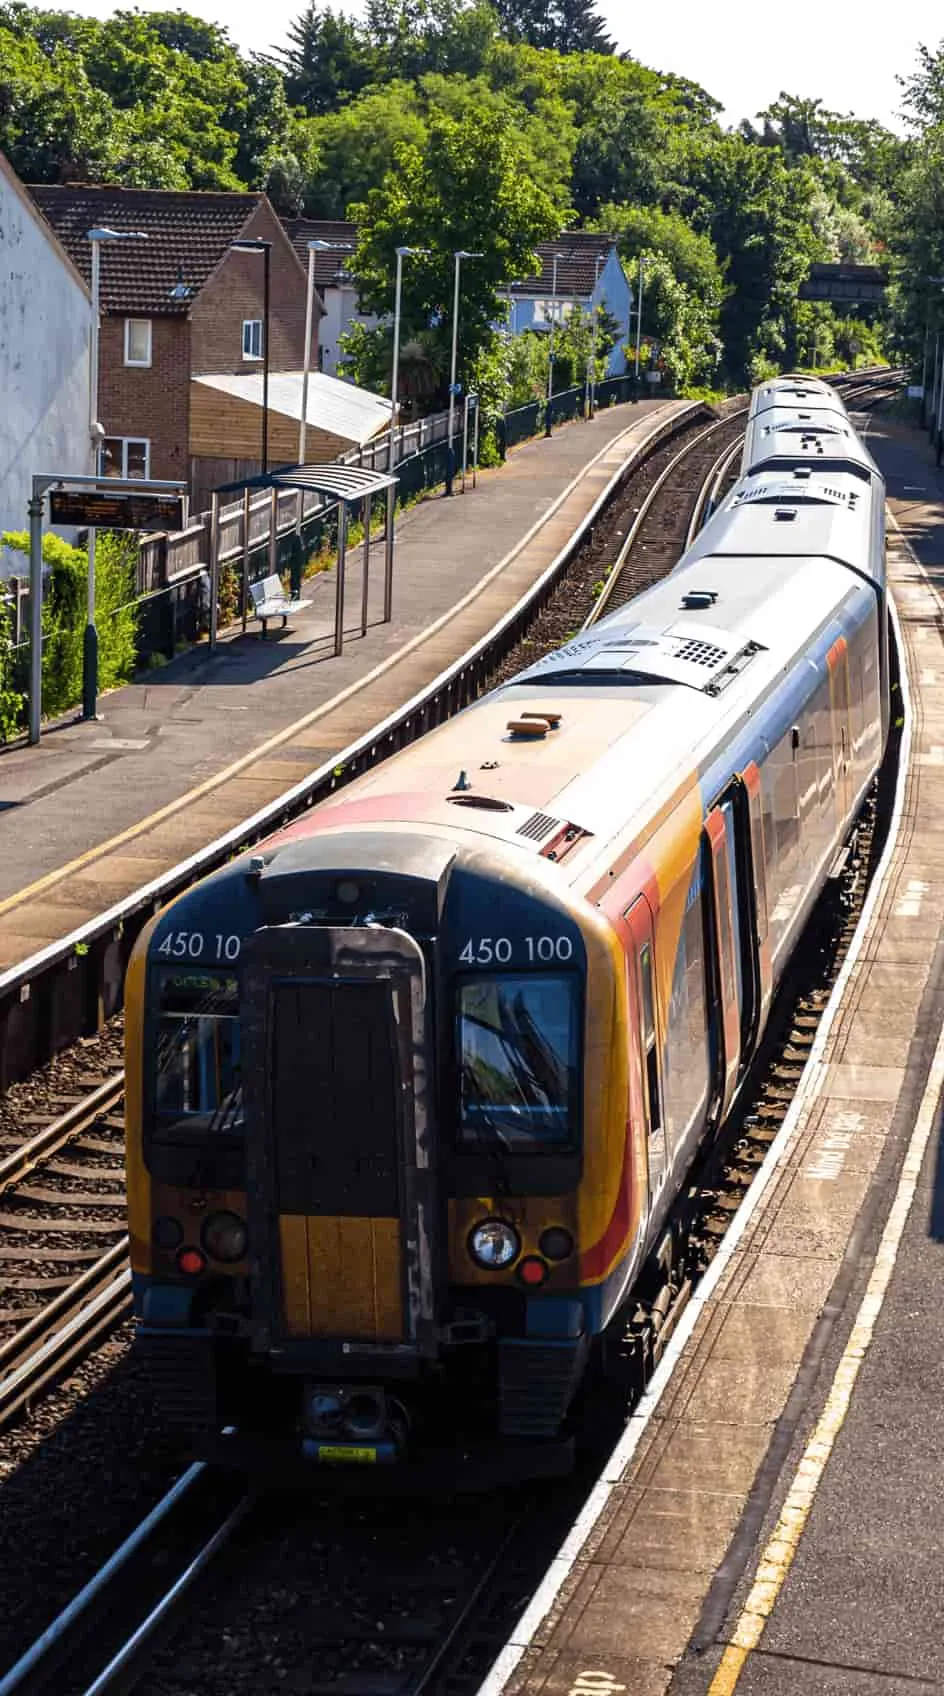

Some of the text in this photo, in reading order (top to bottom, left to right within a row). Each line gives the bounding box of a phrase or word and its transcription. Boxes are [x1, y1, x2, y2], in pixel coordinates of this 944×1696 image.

[158, 931, 204, 957] 450
[458, 936, 573, 963] 450 100
